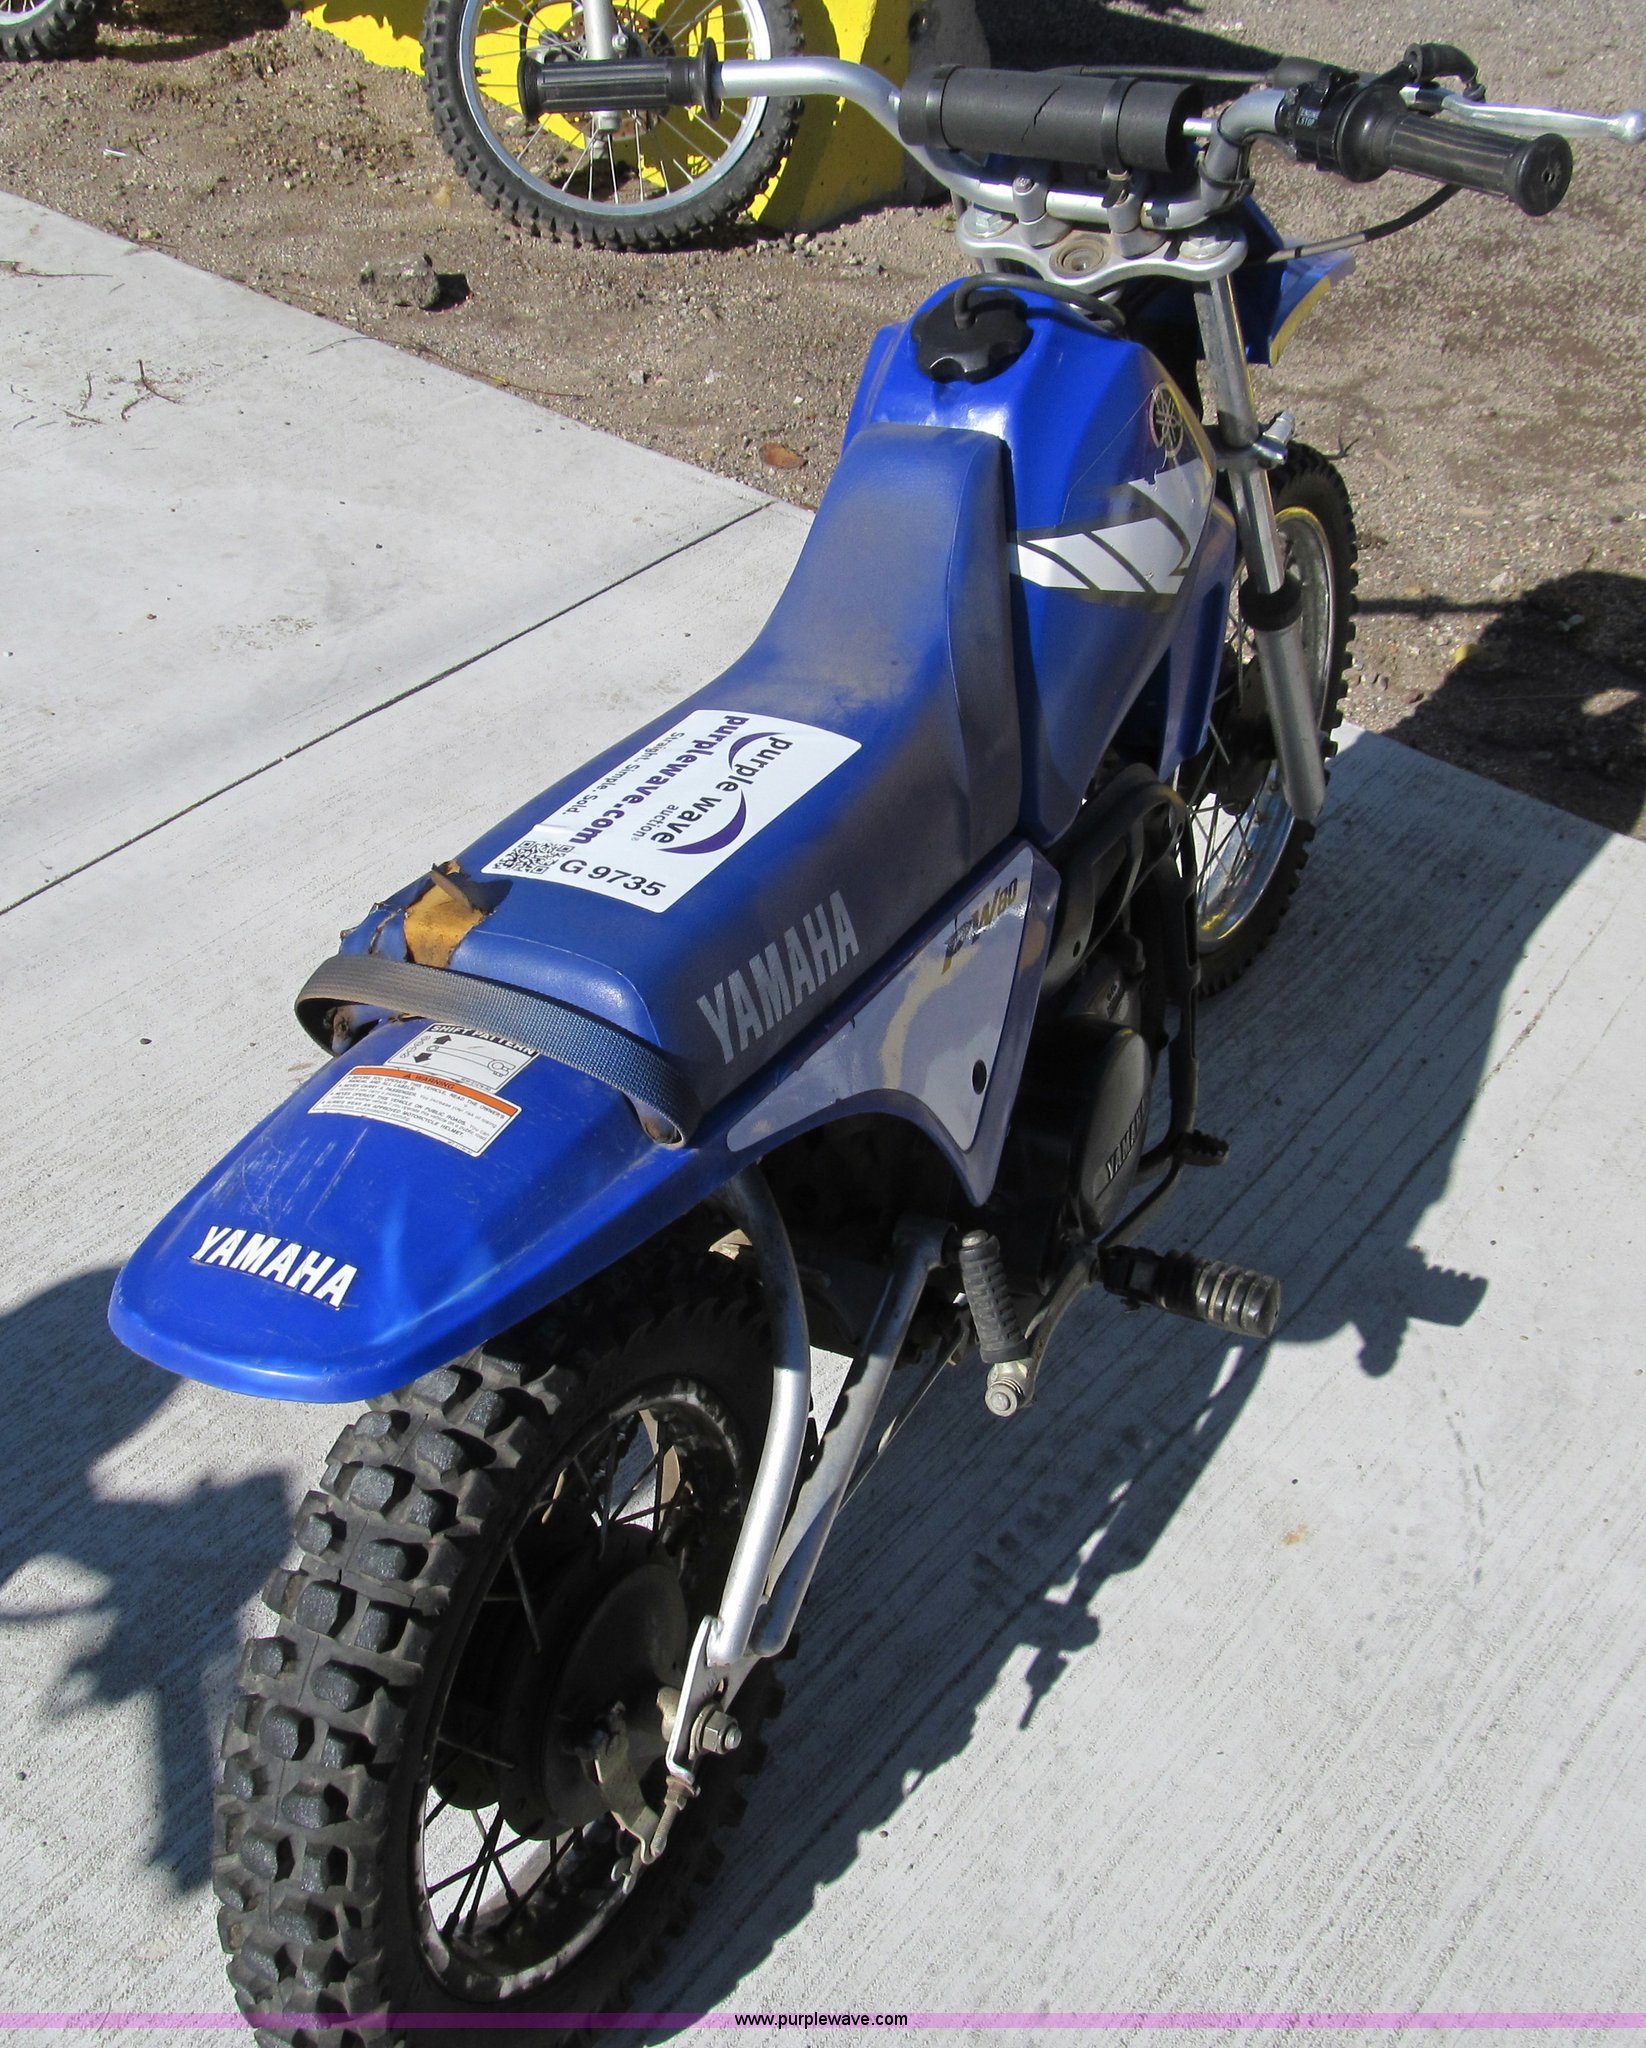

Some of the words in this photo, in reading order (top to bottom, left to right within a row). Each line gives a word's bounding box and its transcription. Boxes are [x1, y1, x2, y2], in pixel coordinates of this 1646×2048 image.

[634, 731, 685, 762] Straight.
[715, 736, 793, 792] purple
[569, 715, 749, 844] purplewave.com
[593, 763, 640, 793] Simple.
[562, 794, 598, 815] Sold.
[650, 796, 722, 844] wave
[559, 859, 587, 874] G
[588, 866, 666, 896] 9735
[696, 890, 860, 1064] YAMAHA
[431, 1025, 472, 1035] SHIFT
[471, 1028, 536, 1056] PATTERN
[415, 1075, 455, 1090] WARNING
[1105, 1097, 1146, 1180] YAMAHA
[192, 1226, 357, 1308] YAMAHA
